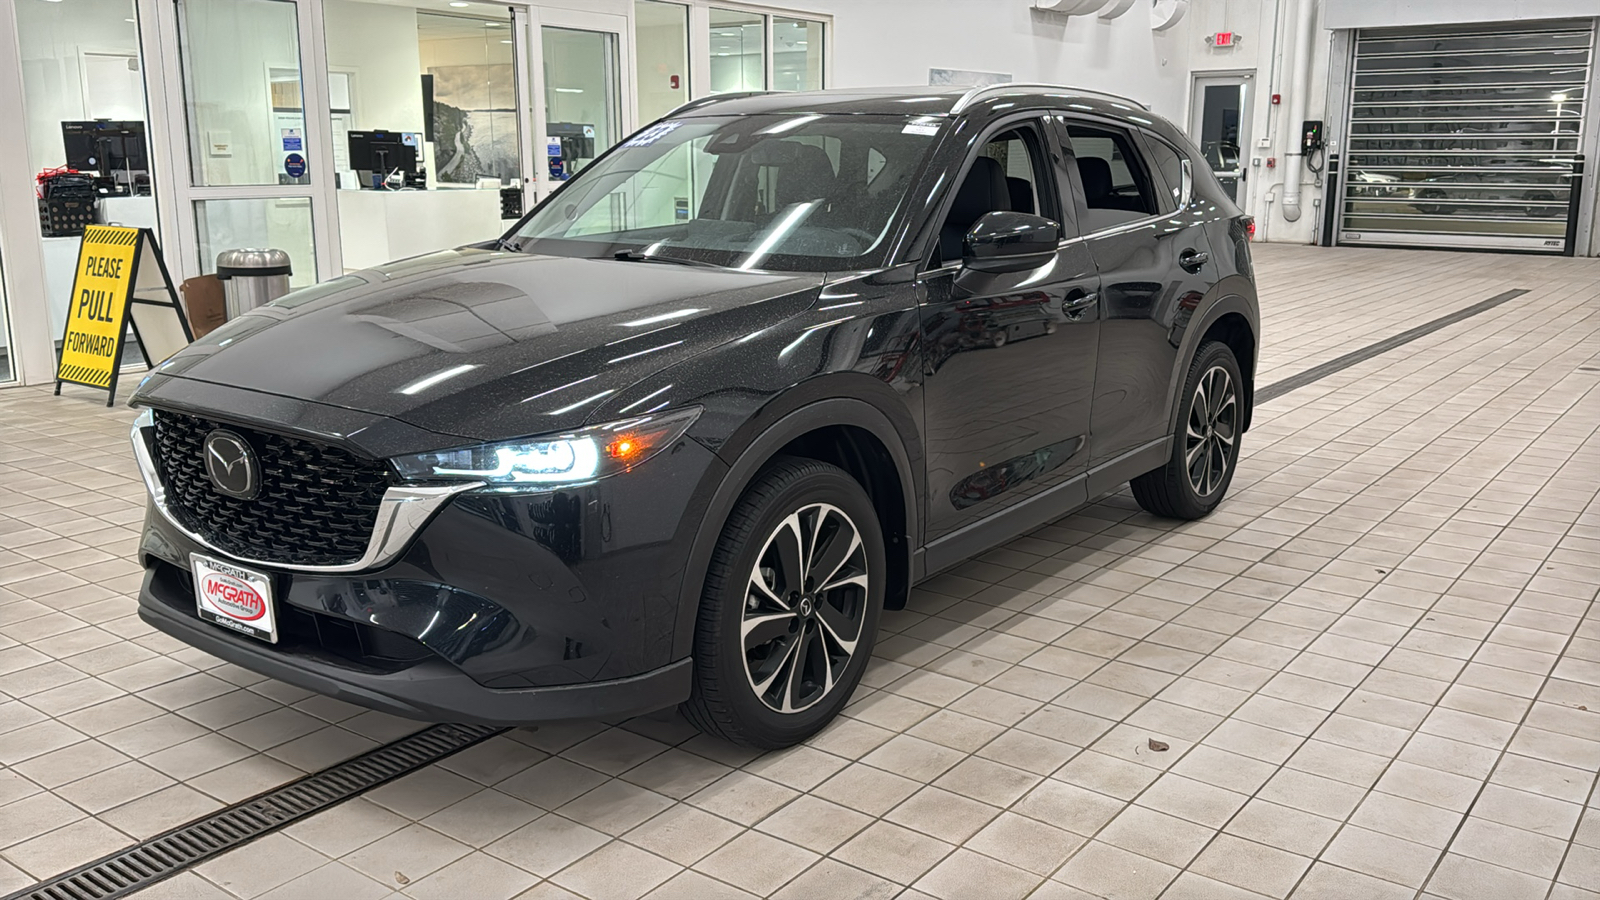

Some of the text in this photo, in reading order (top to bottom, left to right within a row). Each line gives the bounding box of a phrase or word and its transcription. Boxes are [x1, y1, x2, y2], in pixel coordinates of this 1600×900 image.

[85, 256, 124, 279] PLEASE
[77, 288, 114, 323] PULL
[66, 331, 115, 358] FORWARD
[218, 597, 253, 614] Automotive Group
